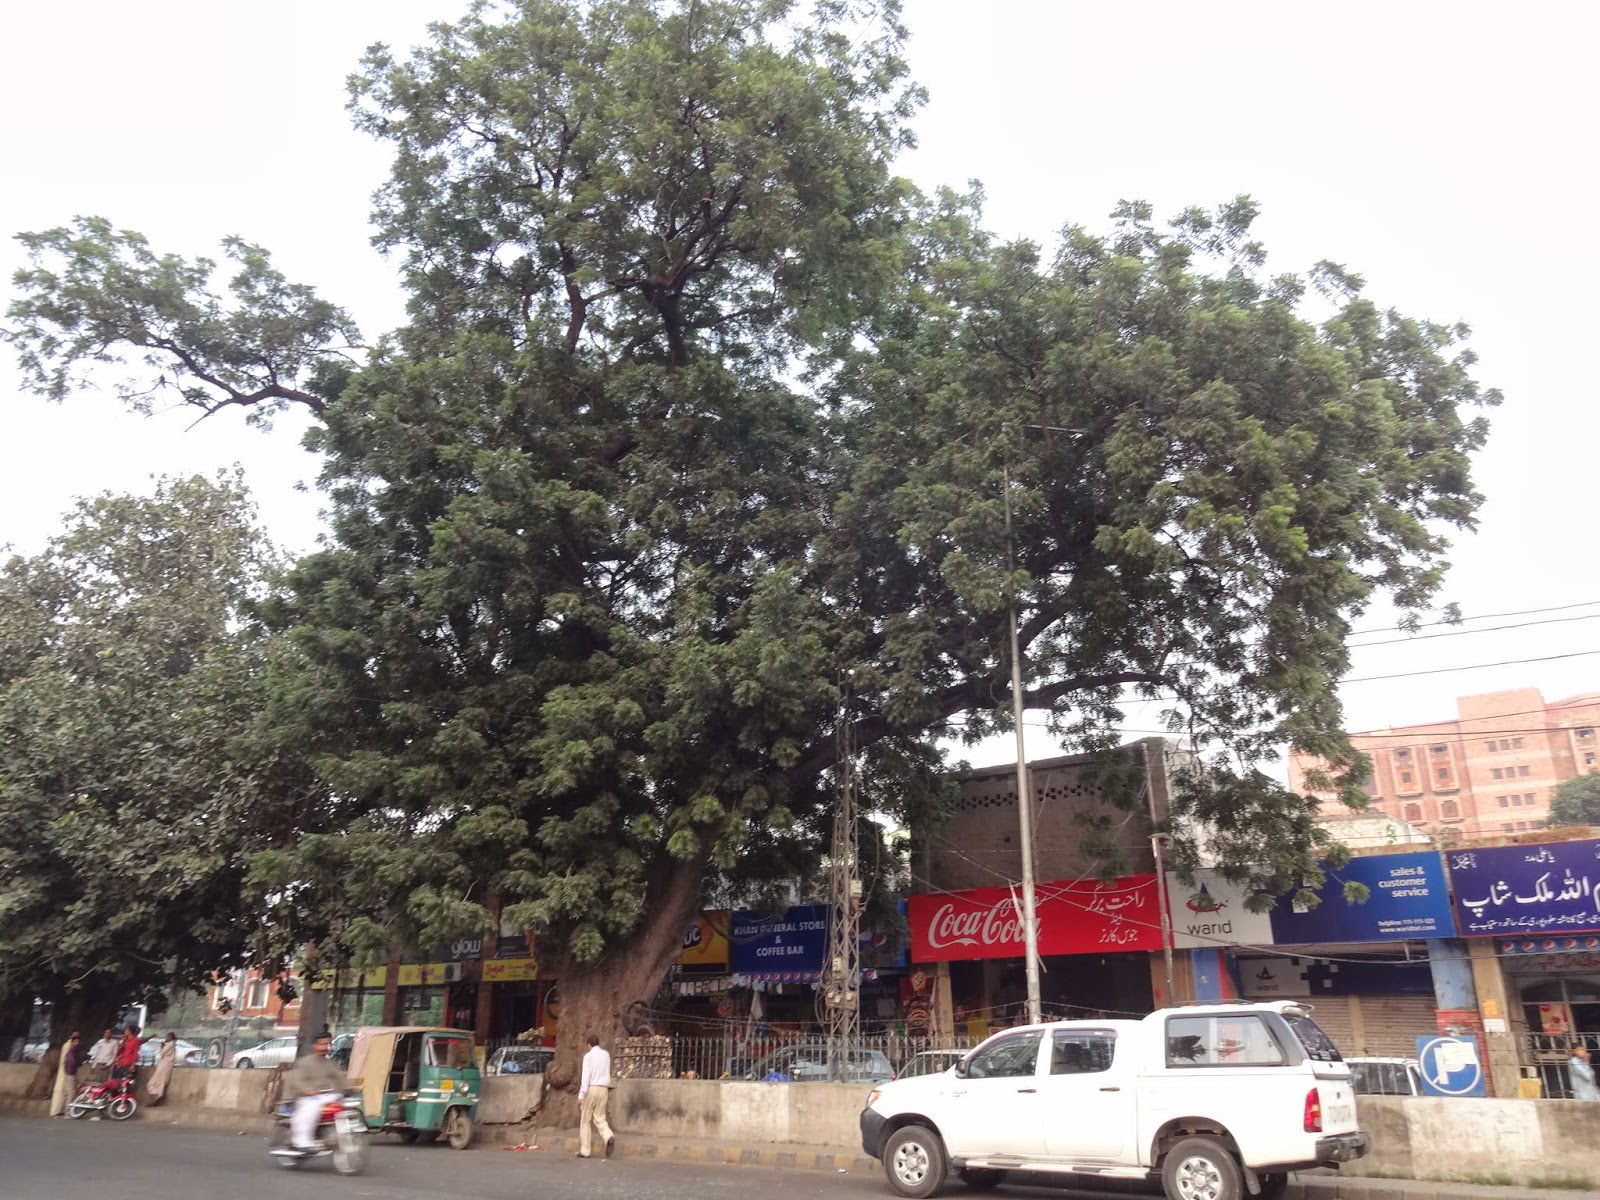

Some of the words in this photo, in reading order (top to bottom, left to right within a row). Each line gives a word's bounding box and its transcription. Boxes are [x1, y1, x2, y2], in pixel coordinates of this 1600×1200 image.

[1390, 867, 1415, 876] sales
[1416, 866, 1425, 875] &
[1378, 878, 1427, 888] customer
[1392, 887, 1429, 897] service
[1462, 881, 1513, 918] شاپ
[734, 925, 758, 935] KHAN
[799, 920, 826, 931] STORE
[928, 896, 1042, 949] Coca-Col
[1186, 920, 1232, 935] warid
[775, 935, 782, 944] &
[756, 946, 785, 957] COFFEE
[786, 945, 804, 955] BAR
